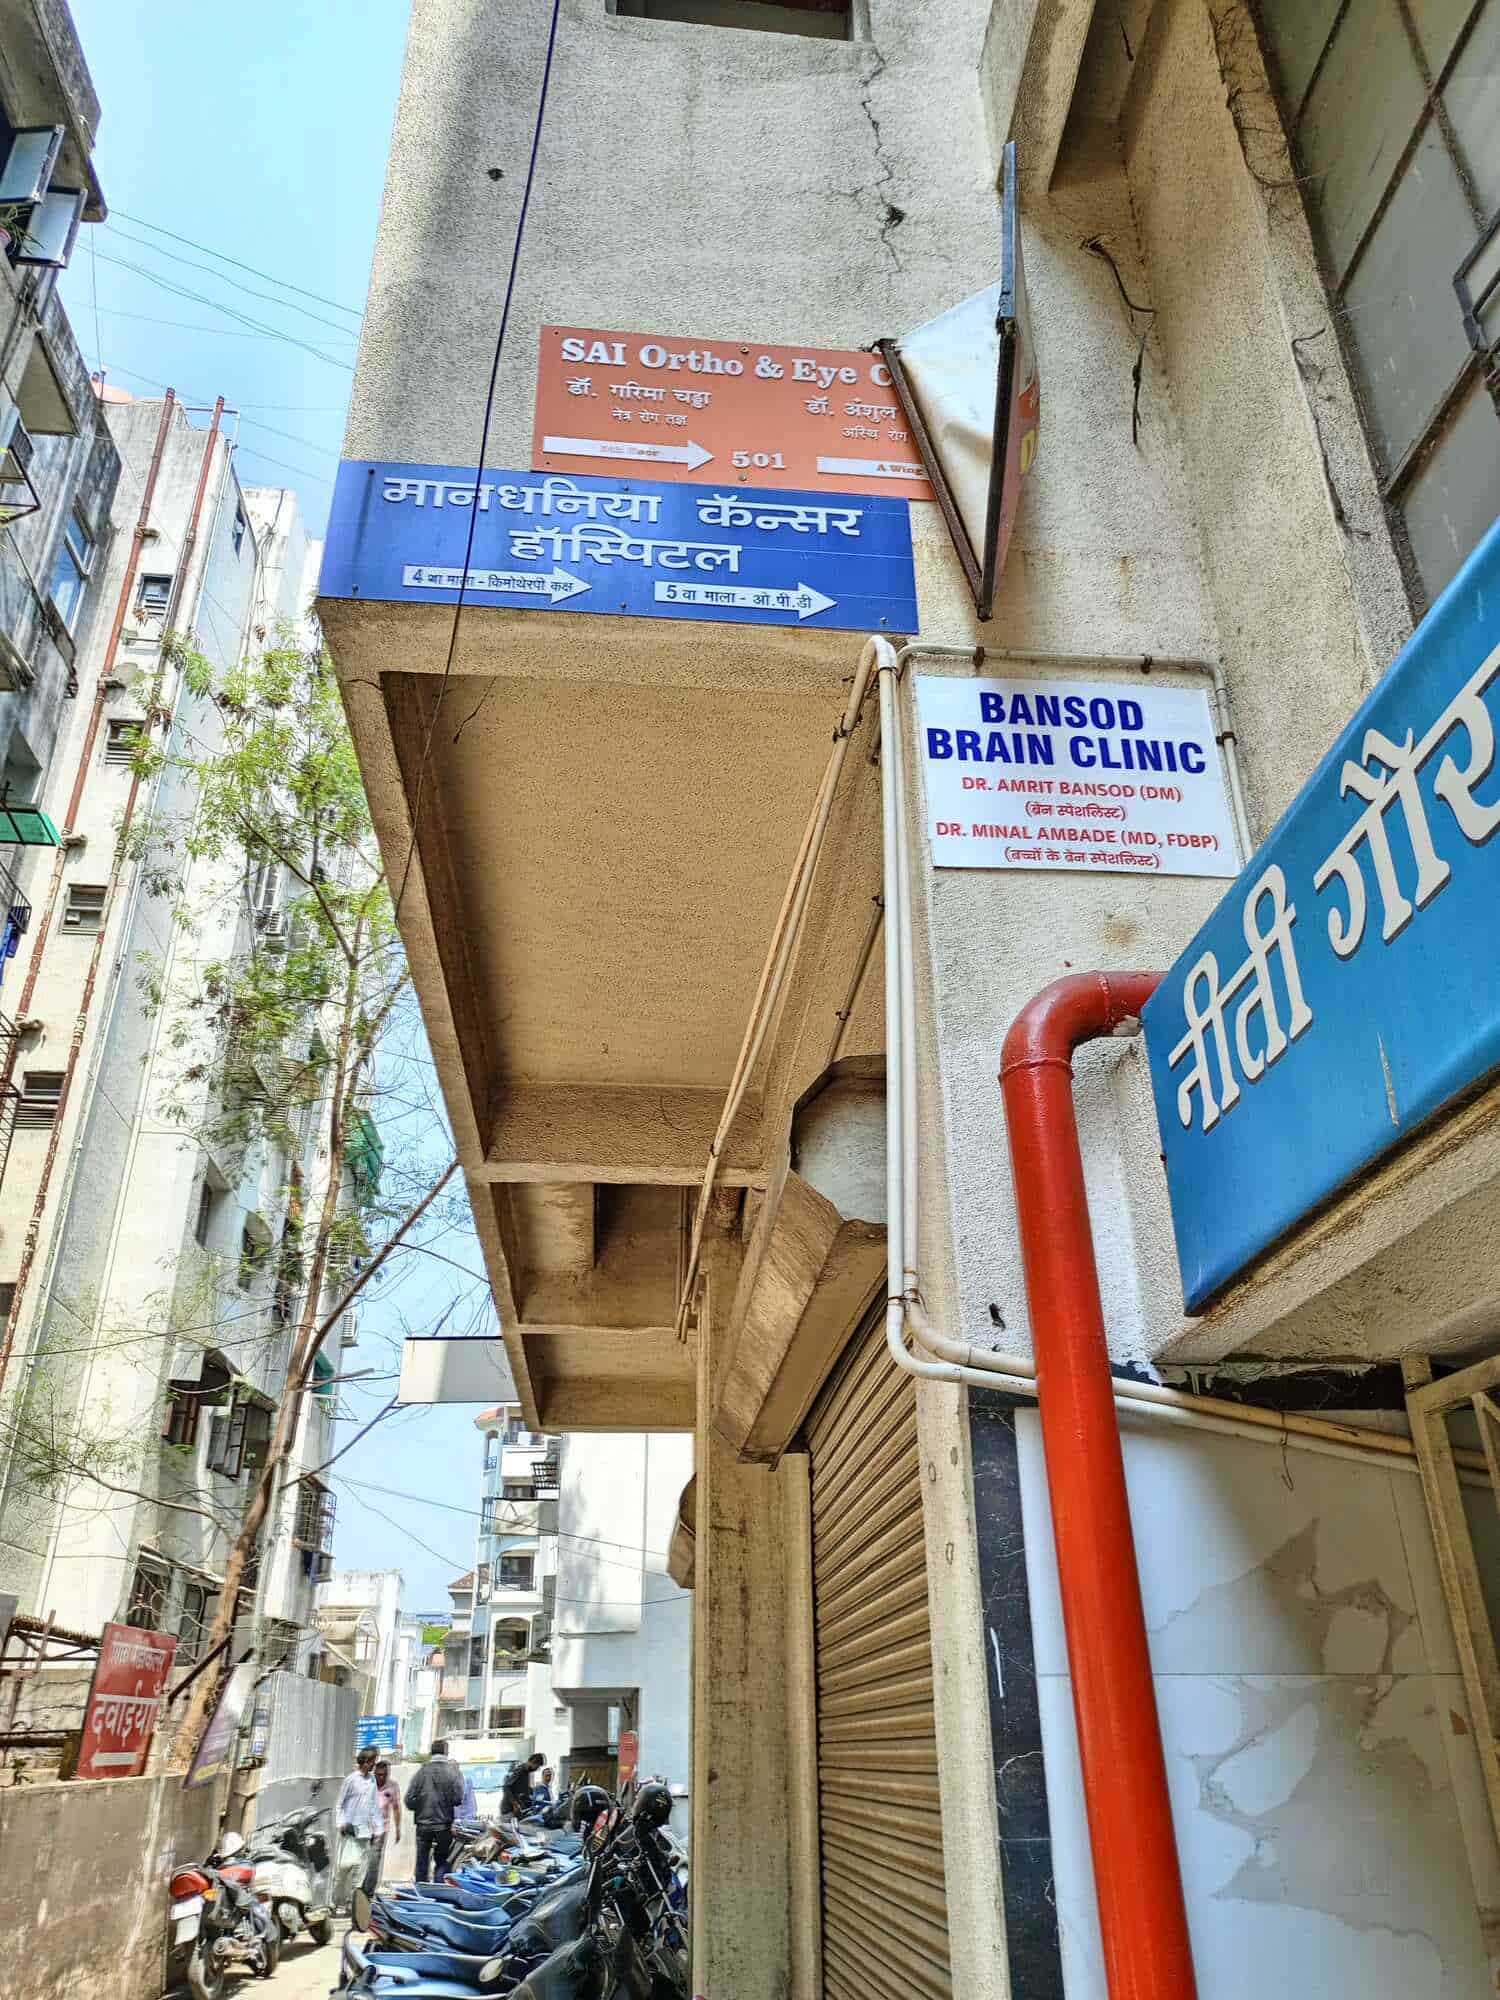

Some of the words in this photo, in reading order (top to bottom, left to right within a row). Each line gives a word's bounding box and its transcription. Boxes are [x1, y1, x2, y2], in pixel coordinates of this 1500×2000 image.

[560, 337, 628, 366] SAI
[639, 343, 744, 377] Ortho
[754, 354, 785, 380] &
[791, 357, 858, 390] Eye
[565, 375, 598, 398] डॉ.
[608, 380, 667, 402] गरिमा
[803, 395, 835, 416] डॉ.
[731, 449, 787, 470] 501
[382, 477, 663, 523] मानधनिया
[696, 493, 865, 537] कॅन्सर
[508, 522, 743, 573] हॉस्पिटल
[666, 584, 677, 600] 5
[682, 589, 697, 601] वा
[704, 590, 737, 604] माला
[978, 691, 1143, 731] BANSOD
[927, 727, 1055, 766] BRAIN
[1069, 735, 1207, 774] CLINIC
[961, 776, 993, 792] DR.
[997, 778, 1055, 795] AMRIT
[1059, 781, 1135, 799] BANSOD
[1140, 784, 1183, 802] (DM)
[936, 821, 967, 838] DR.
[972, 823, 1033, 841] MINAL
[1037, 826, 1117, 844] AMBADE
[1121, 828, 1163, 849] (MD,
[1166, 832, 1219, 852] FDBP)
[1168, 863, 1314, 1135] नीती
[1312, 642, 1500, 962] गौर
